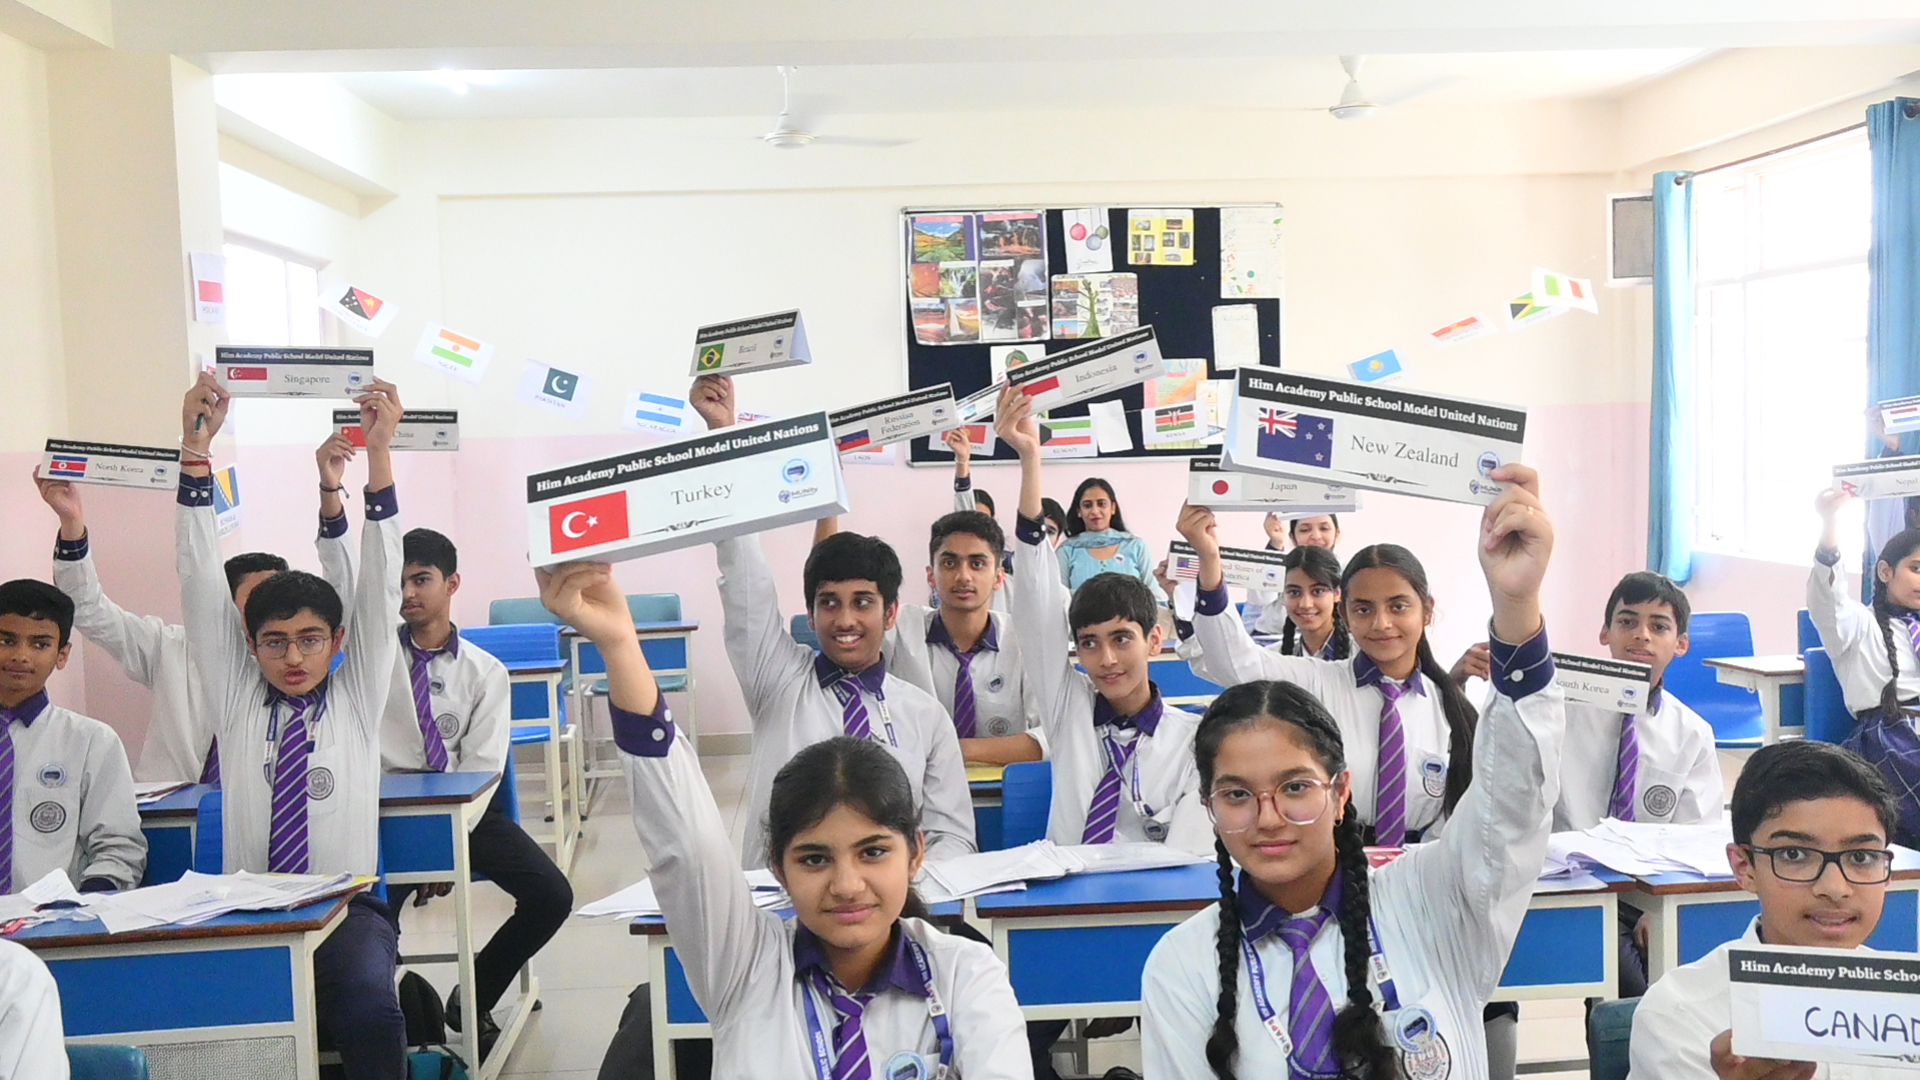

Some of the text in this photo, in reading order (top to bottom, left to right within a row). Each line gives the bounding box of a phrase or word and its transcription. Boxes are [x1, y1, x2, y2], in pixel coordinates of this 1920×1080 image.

[284, 373, 331, 385] Singapore
[1075, 364, 1118, 382] Indonesia
[1248, 378, 1519, 432] Him Academy Public School Model United Nations
[536, 423, 819, 492] Him Academy Public School Model United Nations
[1351, 434, 1459, 468] New Zealand
[95, 462, 144, 473] North Korea
[1270, 482, 1297, 492] Japan
[1896, 478, 1918, 486] Nepal
[671, 483, 734, 505] Turkey
[1582, 682, 1610, 694] Korea
[1740, 960, 1920, 982] Him Academy Public Scho
[1252, 975, 1267, 1008] ACADEMY
[1268, 1019, 1287, 1044] HAPS
